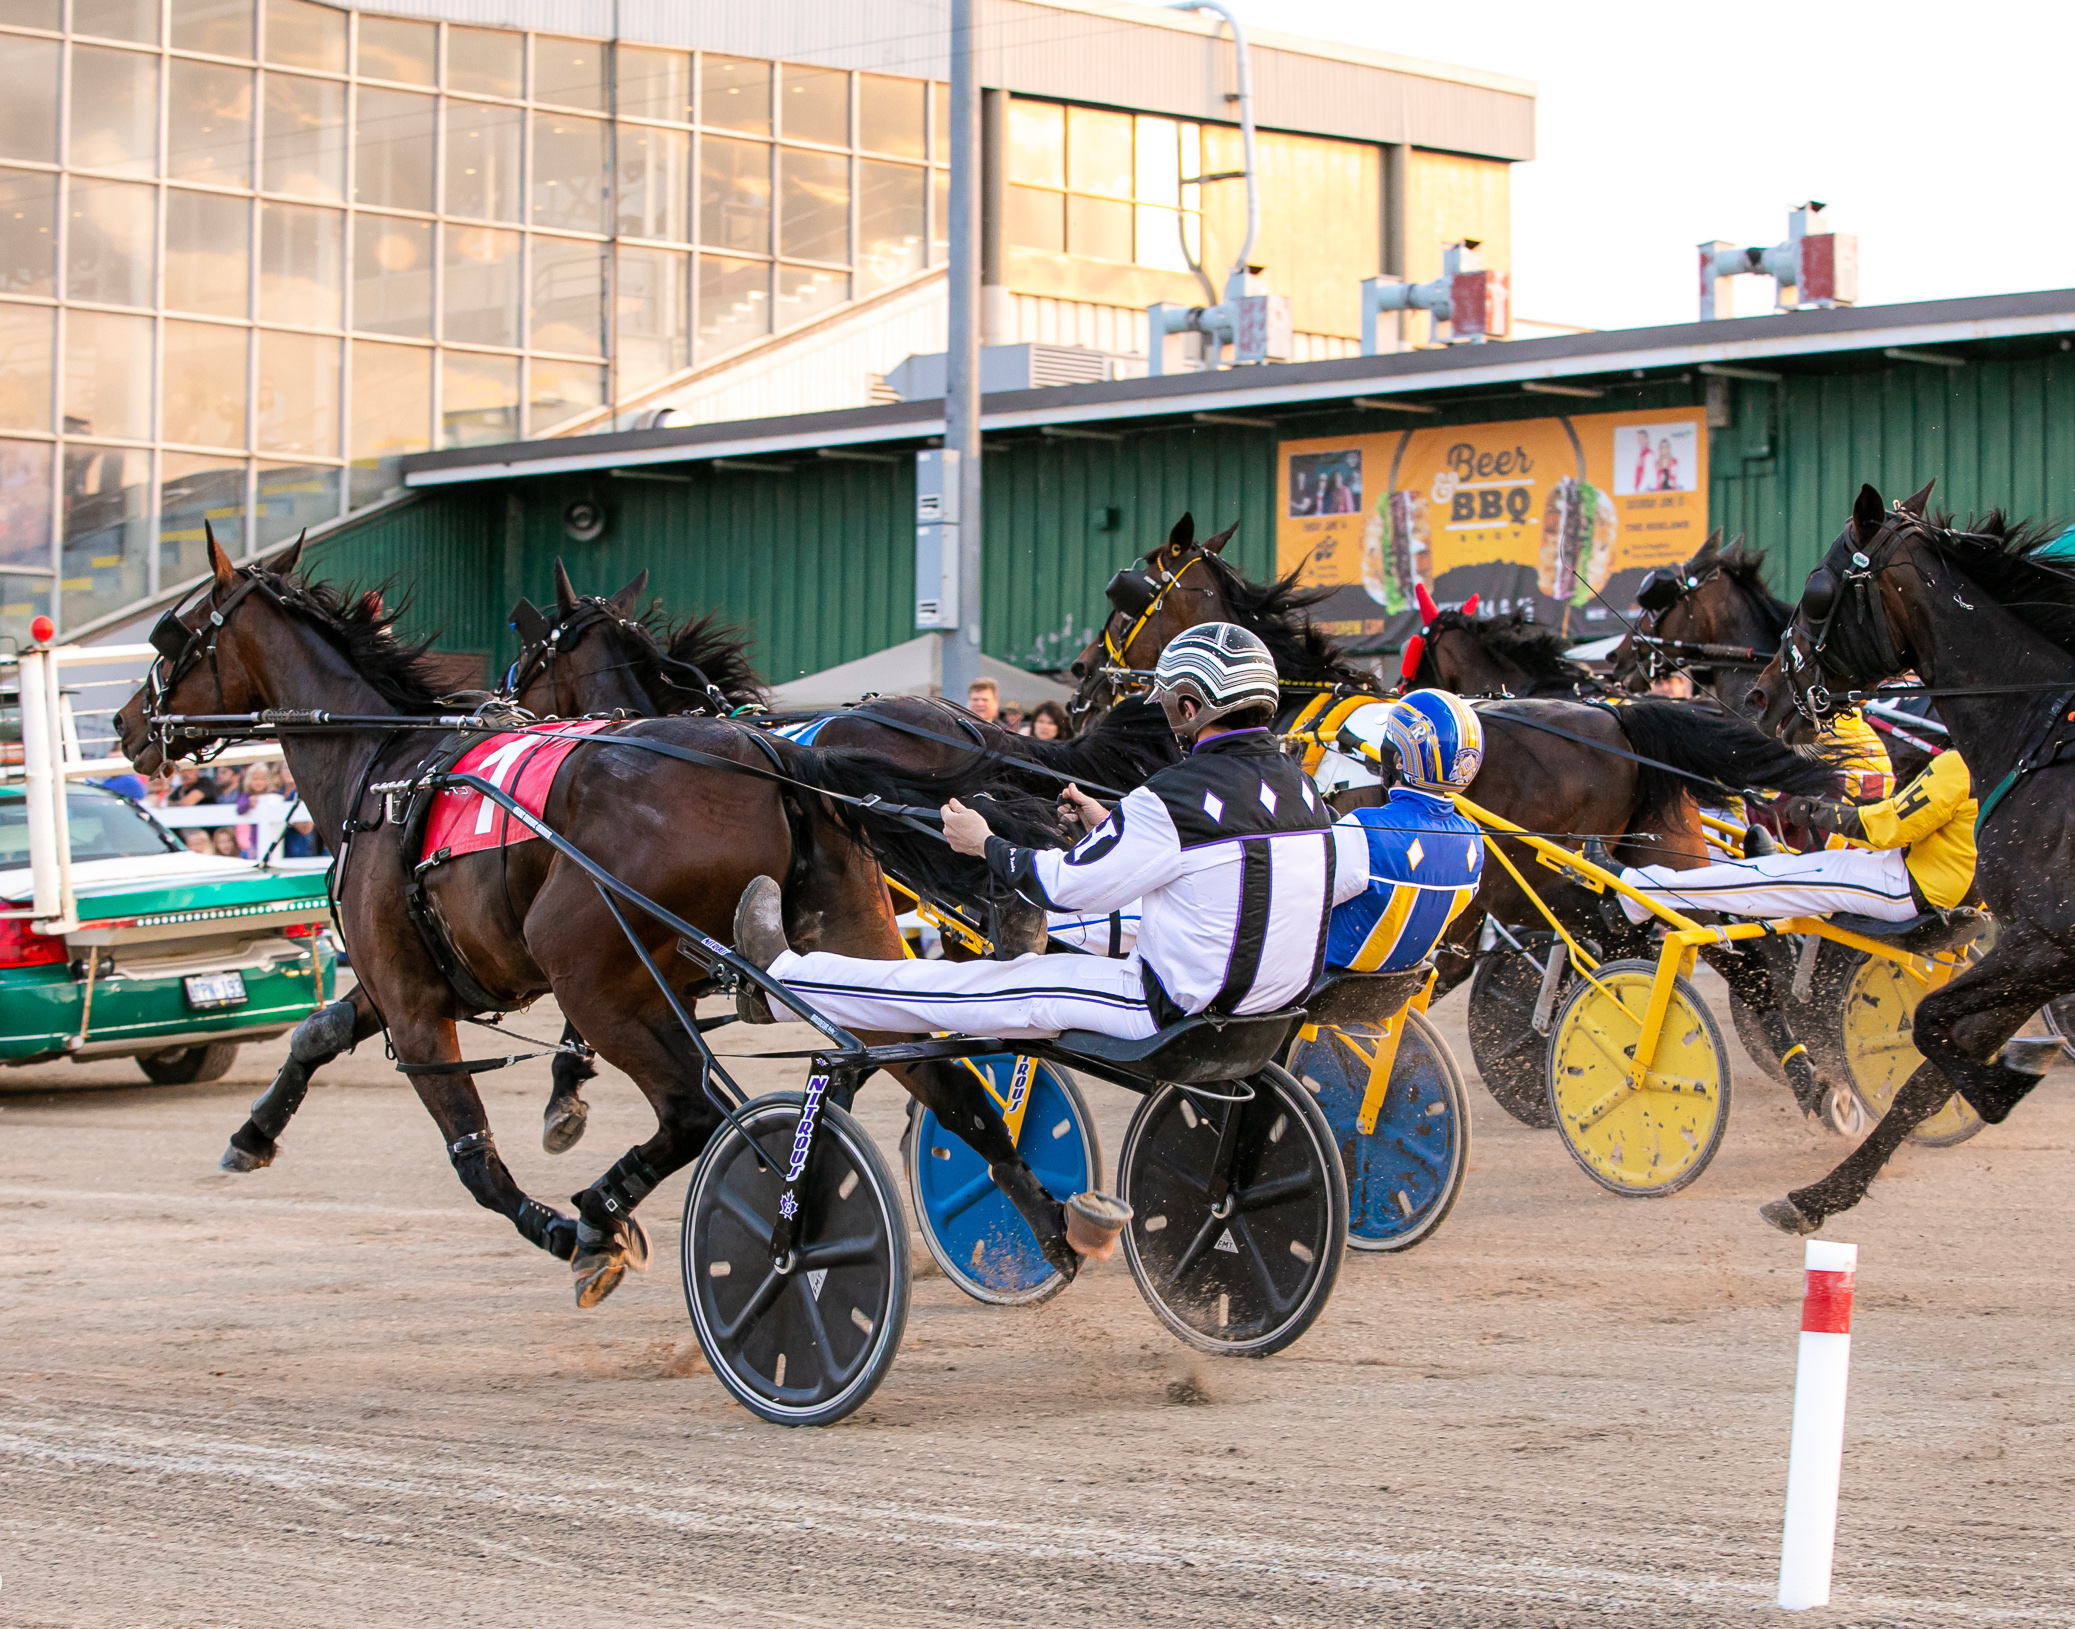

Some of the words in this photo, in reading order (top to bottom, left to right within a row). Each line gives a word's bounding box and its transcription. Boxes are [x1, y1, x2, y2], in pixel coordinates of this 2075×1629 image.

[1430, 471, 1459, 504] &
[1451, 488, 1531, 525] BBQ
[1446, 442, 1534, 482] Beer
[475, 734, 542, 835] 1
[786, 1074, 830, 1182] NITROUS
